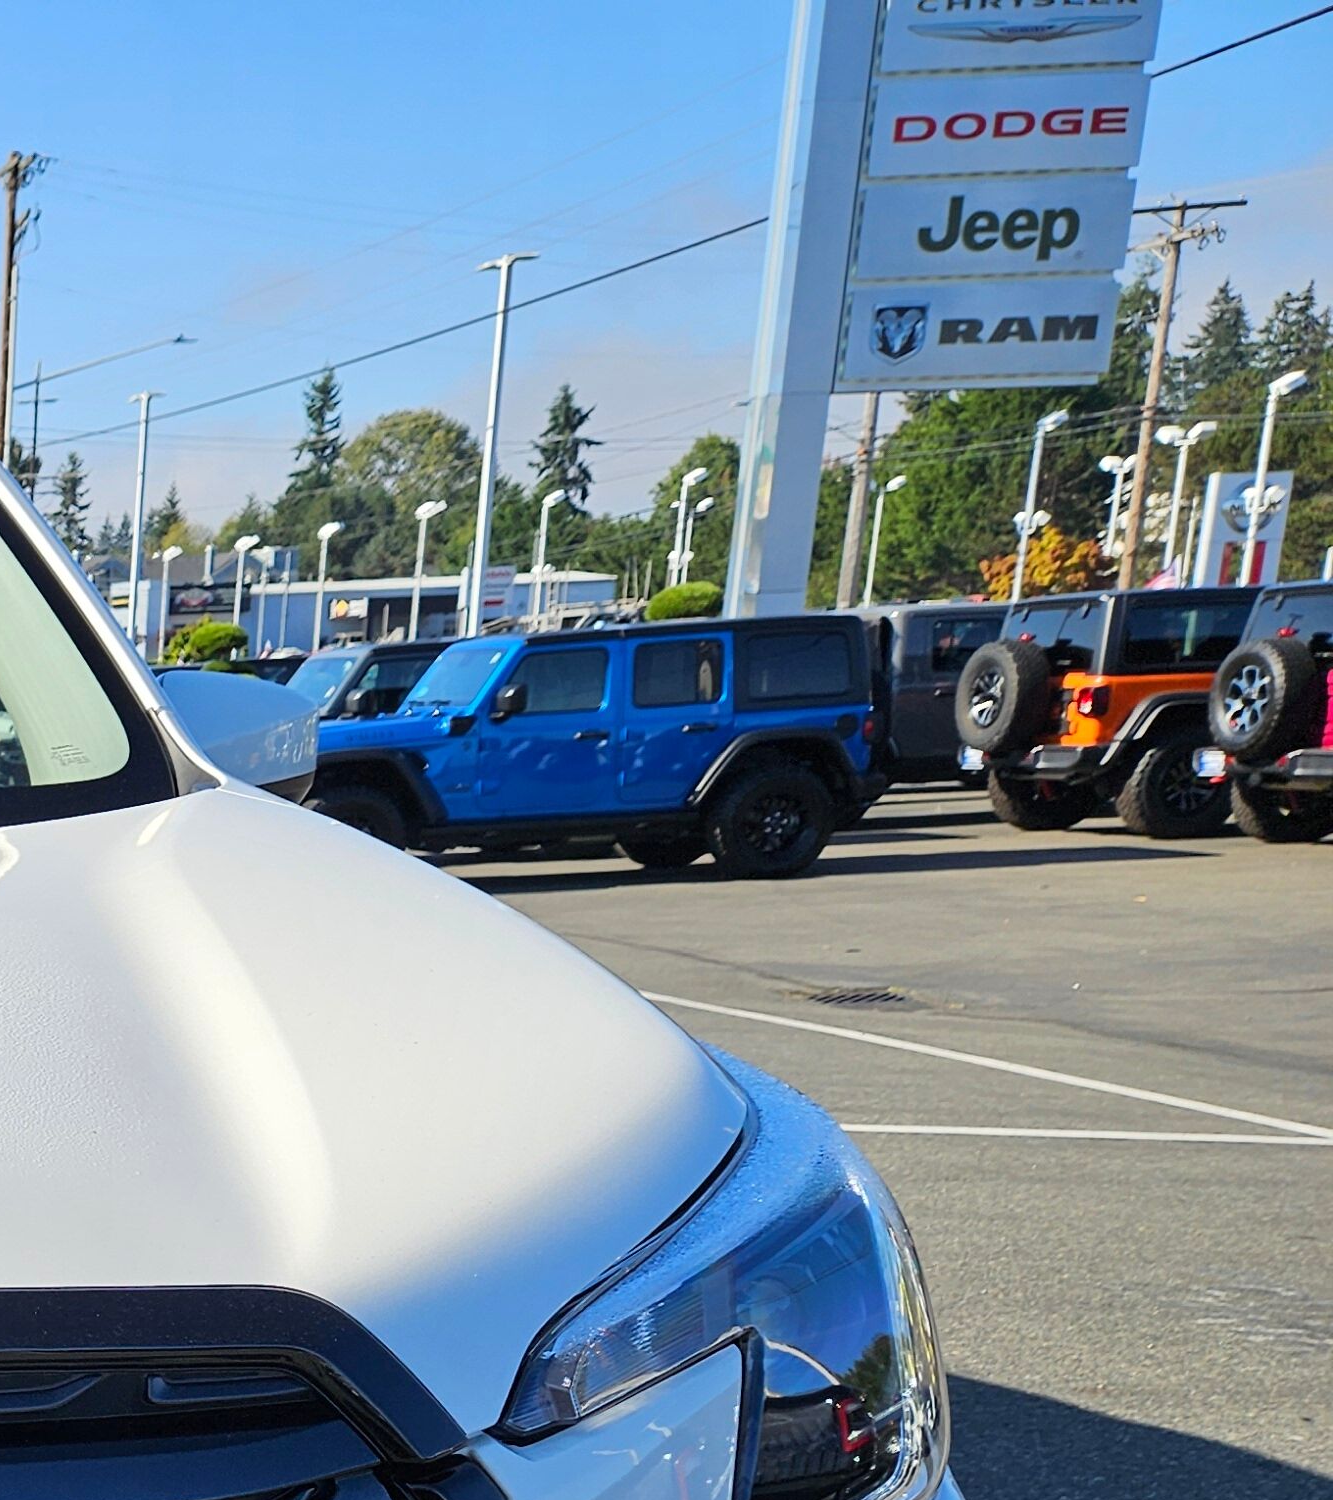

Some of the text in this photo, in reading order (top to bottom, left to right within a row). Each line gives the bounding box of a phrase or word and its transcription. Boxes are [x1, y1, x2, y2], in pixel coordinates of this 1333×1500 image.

[893, 107, 1130, 143] DODGE
[917, 195, 1081, 261] Jeep
[938, 314, 1100, 345] RAM
